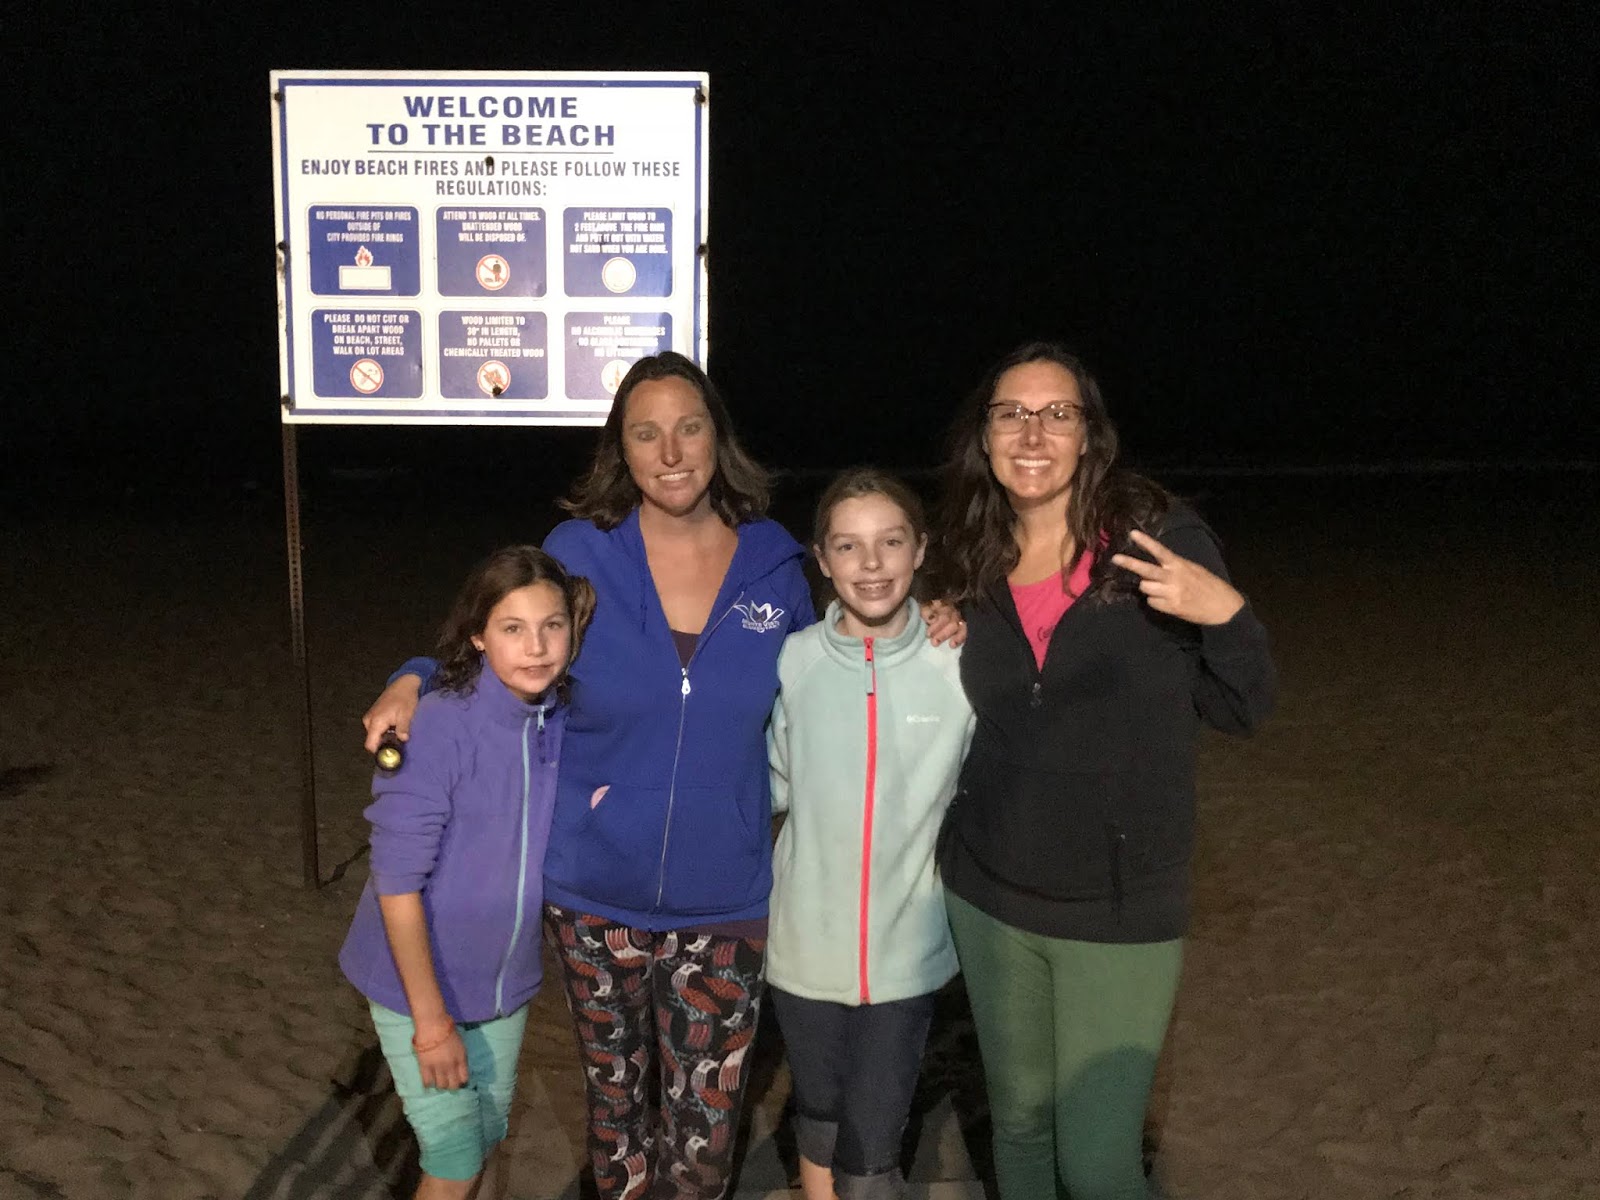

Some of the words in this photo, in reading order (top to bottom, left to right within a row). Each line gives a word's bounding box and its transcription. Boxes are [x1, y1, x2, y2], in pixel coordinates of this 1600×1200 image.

[403, 96, 577, 118] WELCOME
[366, 124, 408, 146] TO
[422, 124, 486, 146] THE
[502, 124, 614, 146] BEACH
[301, 160, 350, 176] ENJOY
[355, 160, 408, 176] BEACH
[414, 160, 458, 176] FIRES
[464, 160, 495, 176] AND
[501, 160, 558, 176] PLEASE
[565, 160, 626, 176] FOLLOW
[633, 160, 680, 176] THESE
[436, 180, 547, 196] REGULATIONS:
[316, 211, 324, 220] NO
[326, 211, 355, 220] PERSONAL
[356, 211, 369, 220] FIRE
[371, 211, 384, 220] PITS
[443, 211, 467, 220] ATTEND
[469, 211, 476, 220] TO
[478, 211, 497, 220] WOOD
[499, 211, 506, 220] AT
[507, 211, 518, 220] ALL
[584, 212, 607, 221] PLEASE
[504, 222, 522, 231] WOOD
[575, 223, 579, 232] 2
[327, 233, 340, 242] CITY
[372, 233, 384, 242] FIRE
[459, 233, 473, 242] WILL
[475, 233, 483, 242] BE
[485, 233, 515, 242] DISPOSED
[324, 314, 350, 323] PLEASE
[355, 314, 364, 323] DO
[367, 314, 381, 323] NOT
[382, 314, 397, 323] CUT
[399, 314, 409, 323] OR
[462, 316, 483, 325] WOOD
[485, 316, 514, 325] LIMITED
[516, 316, 525, 325] TO
[332, 325, 356, 334] BREAK
[358, 325, 380, 334] APART
[382, 325, 404, 334] WOOD
[481, 327, 489, 336] IN
[334, 336, 344, 345] ON
[346, 336, 372, 345] BEACH,
[375, 336, 402, 345] STREET,
[467, 338, 477, 346] NO
[479, 338, 508, 346] PALLETS
[510, 338, 520, 346] OR
[333, 346, 353, 355] WALK
[355, 346, 364, 355] OR
[367, 346, 379, 355] LOT
[382, 346, 404, 355] AREAS
[444, 348, 488, 357] CHEMICALLY
[490, 348, 520, 357] TREATED
[523, 348, 544, 357] WOOD
